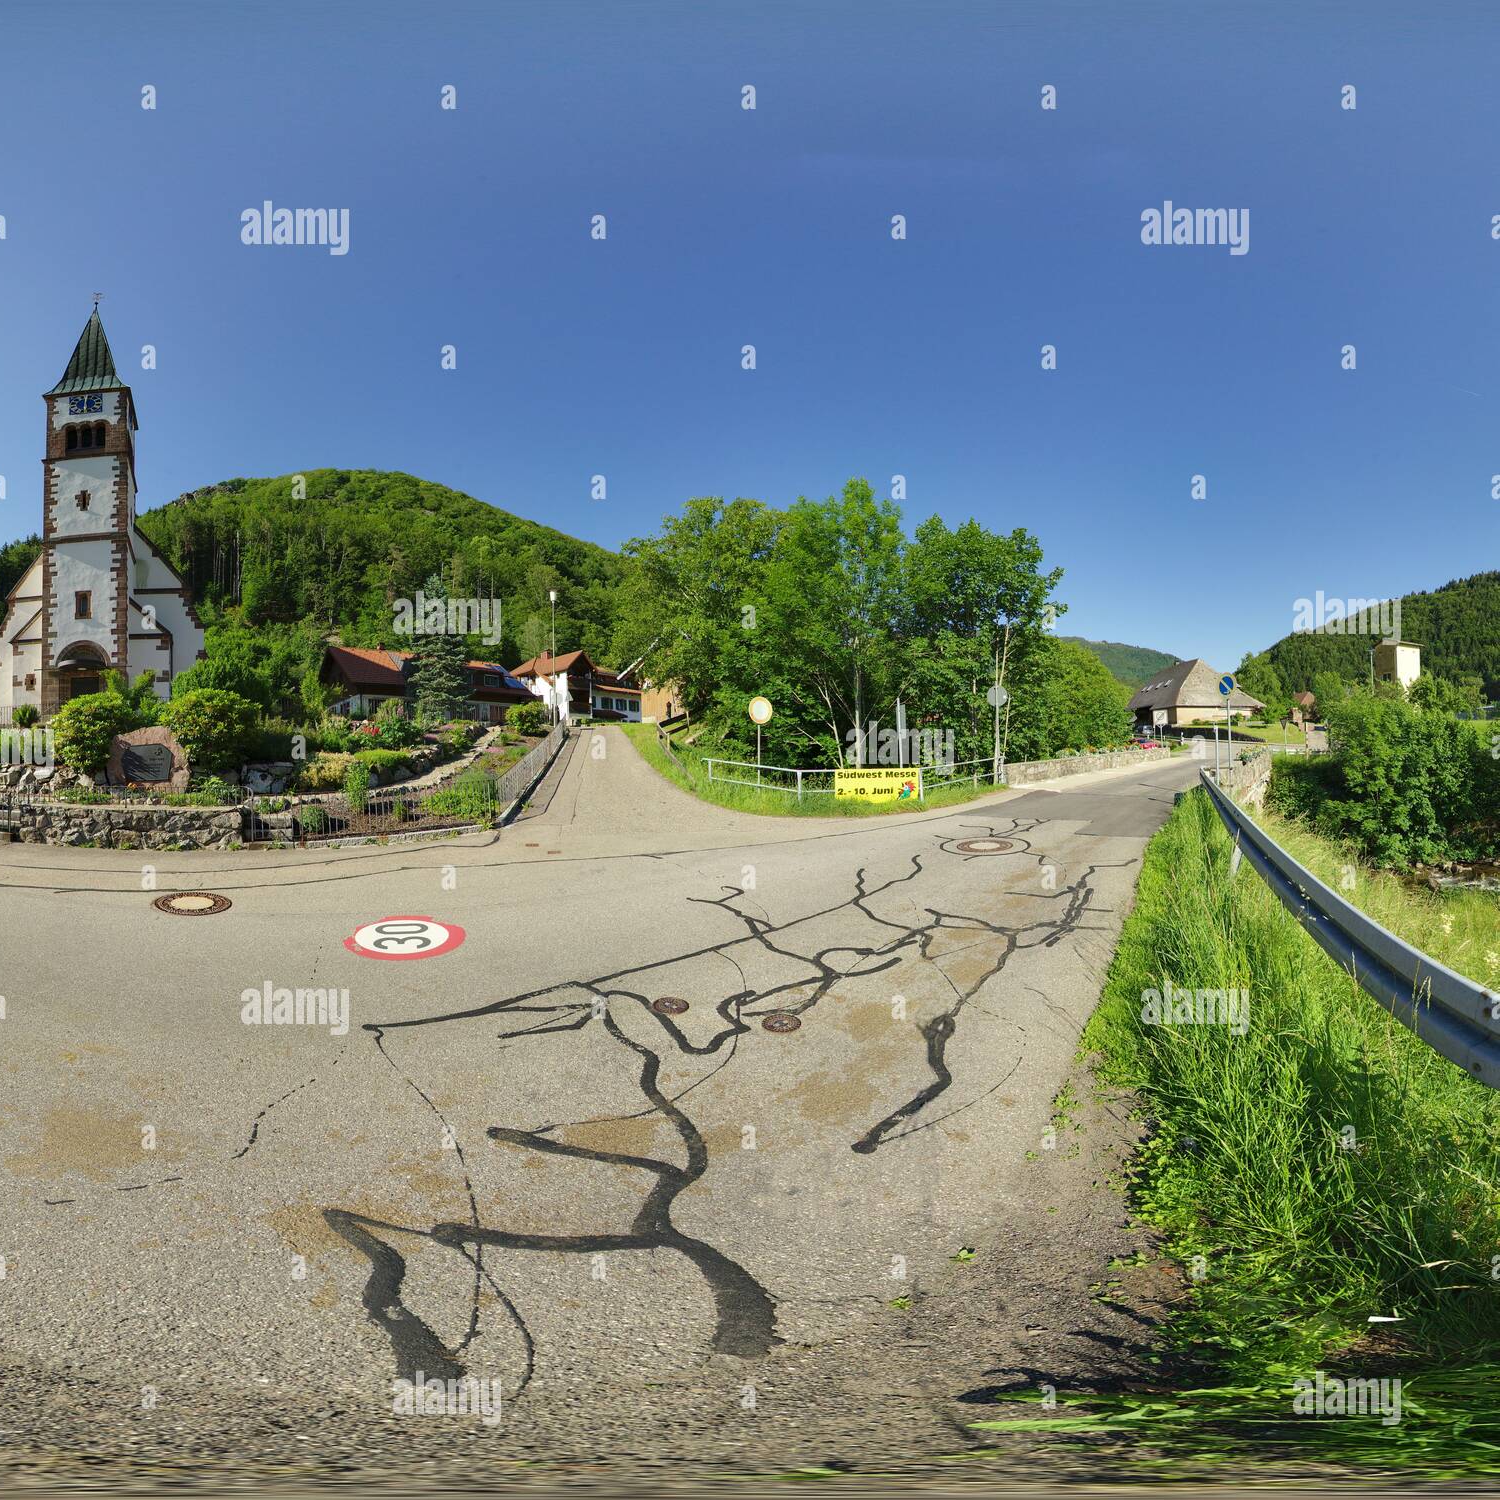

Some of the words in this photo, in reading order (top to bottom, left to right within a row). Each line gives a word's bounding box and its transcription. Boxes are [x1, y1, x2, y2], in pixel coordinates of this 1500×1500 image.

[837, 771, 882, 779] Südwest
[871, 787, 894, 795] Juni
[373, 923, 431, 950] 30
